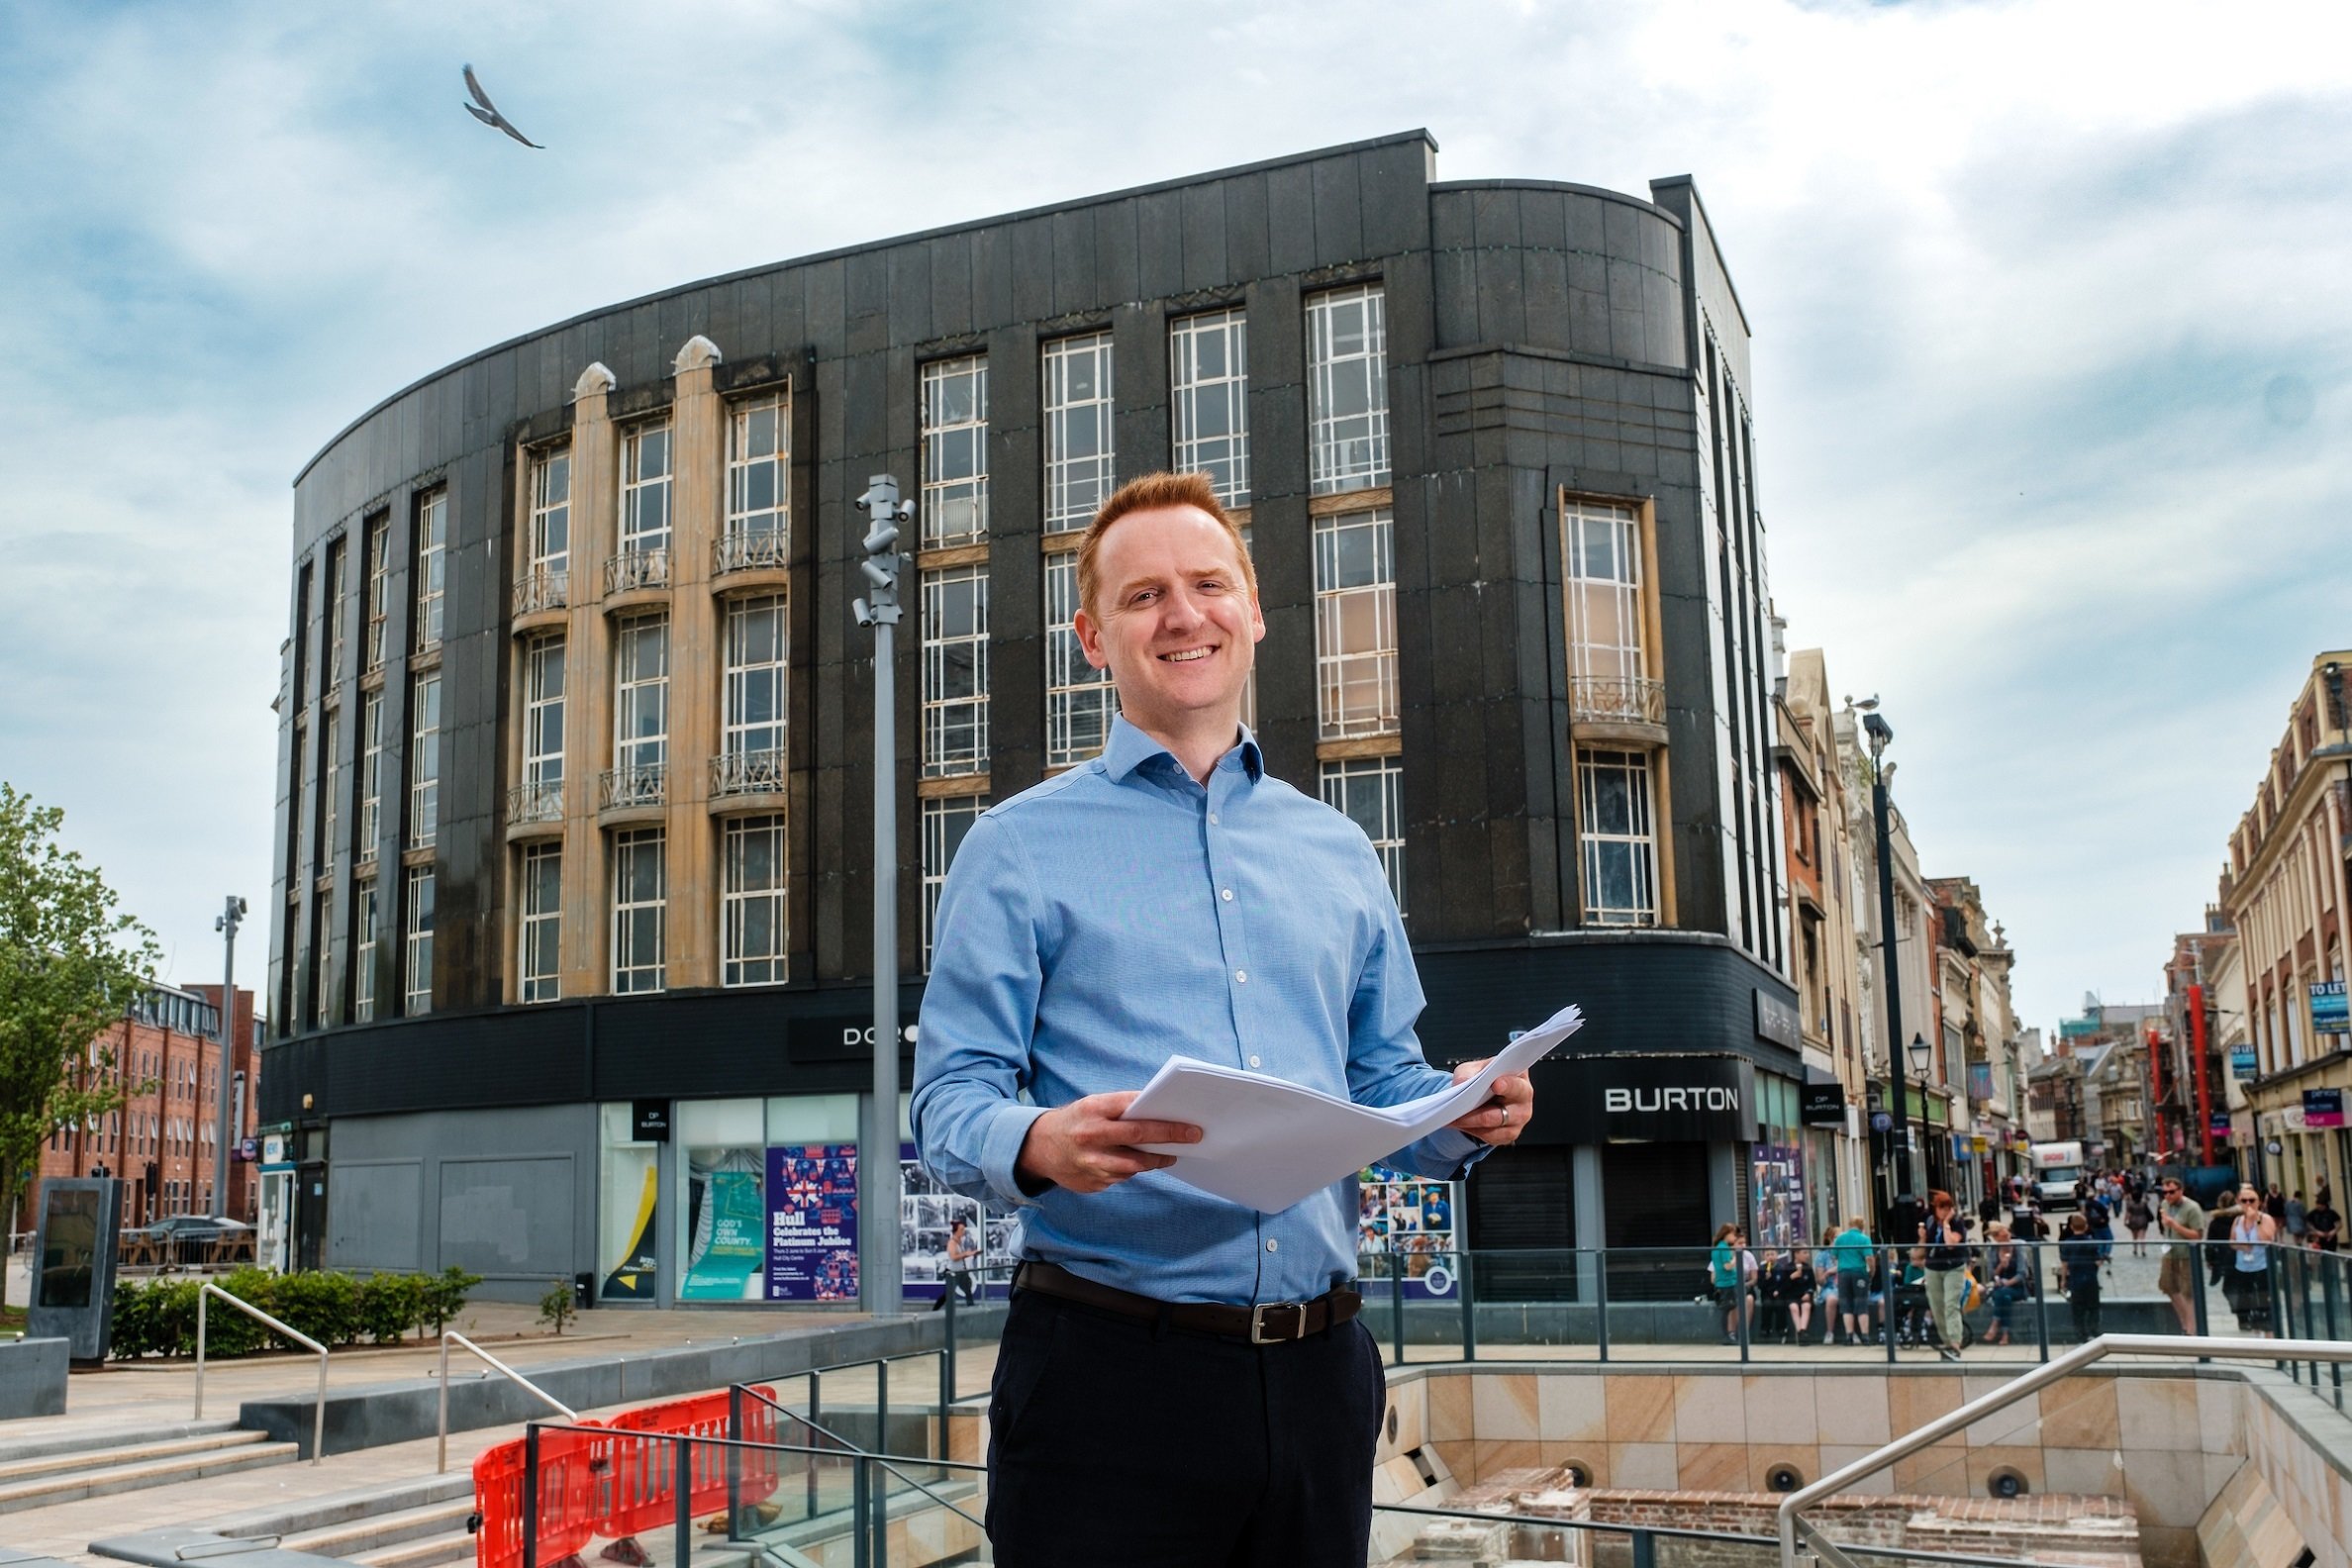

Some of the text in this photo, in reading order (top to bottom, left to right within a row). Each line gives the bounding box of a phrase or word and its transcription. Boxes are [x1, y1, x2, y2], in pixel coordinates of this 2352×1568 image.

[2309, 982, 2347, 995] TO LET
[1605, 1087, 1739, 1112] BURTON
[717, 1219, 742, 1227] GOD'S
[773, 1211, 806, 1226] Hull
[773, 1225, 839, 1236] Celebrates the
[773, 1235, 851, 1246] Platinum Jubilee
